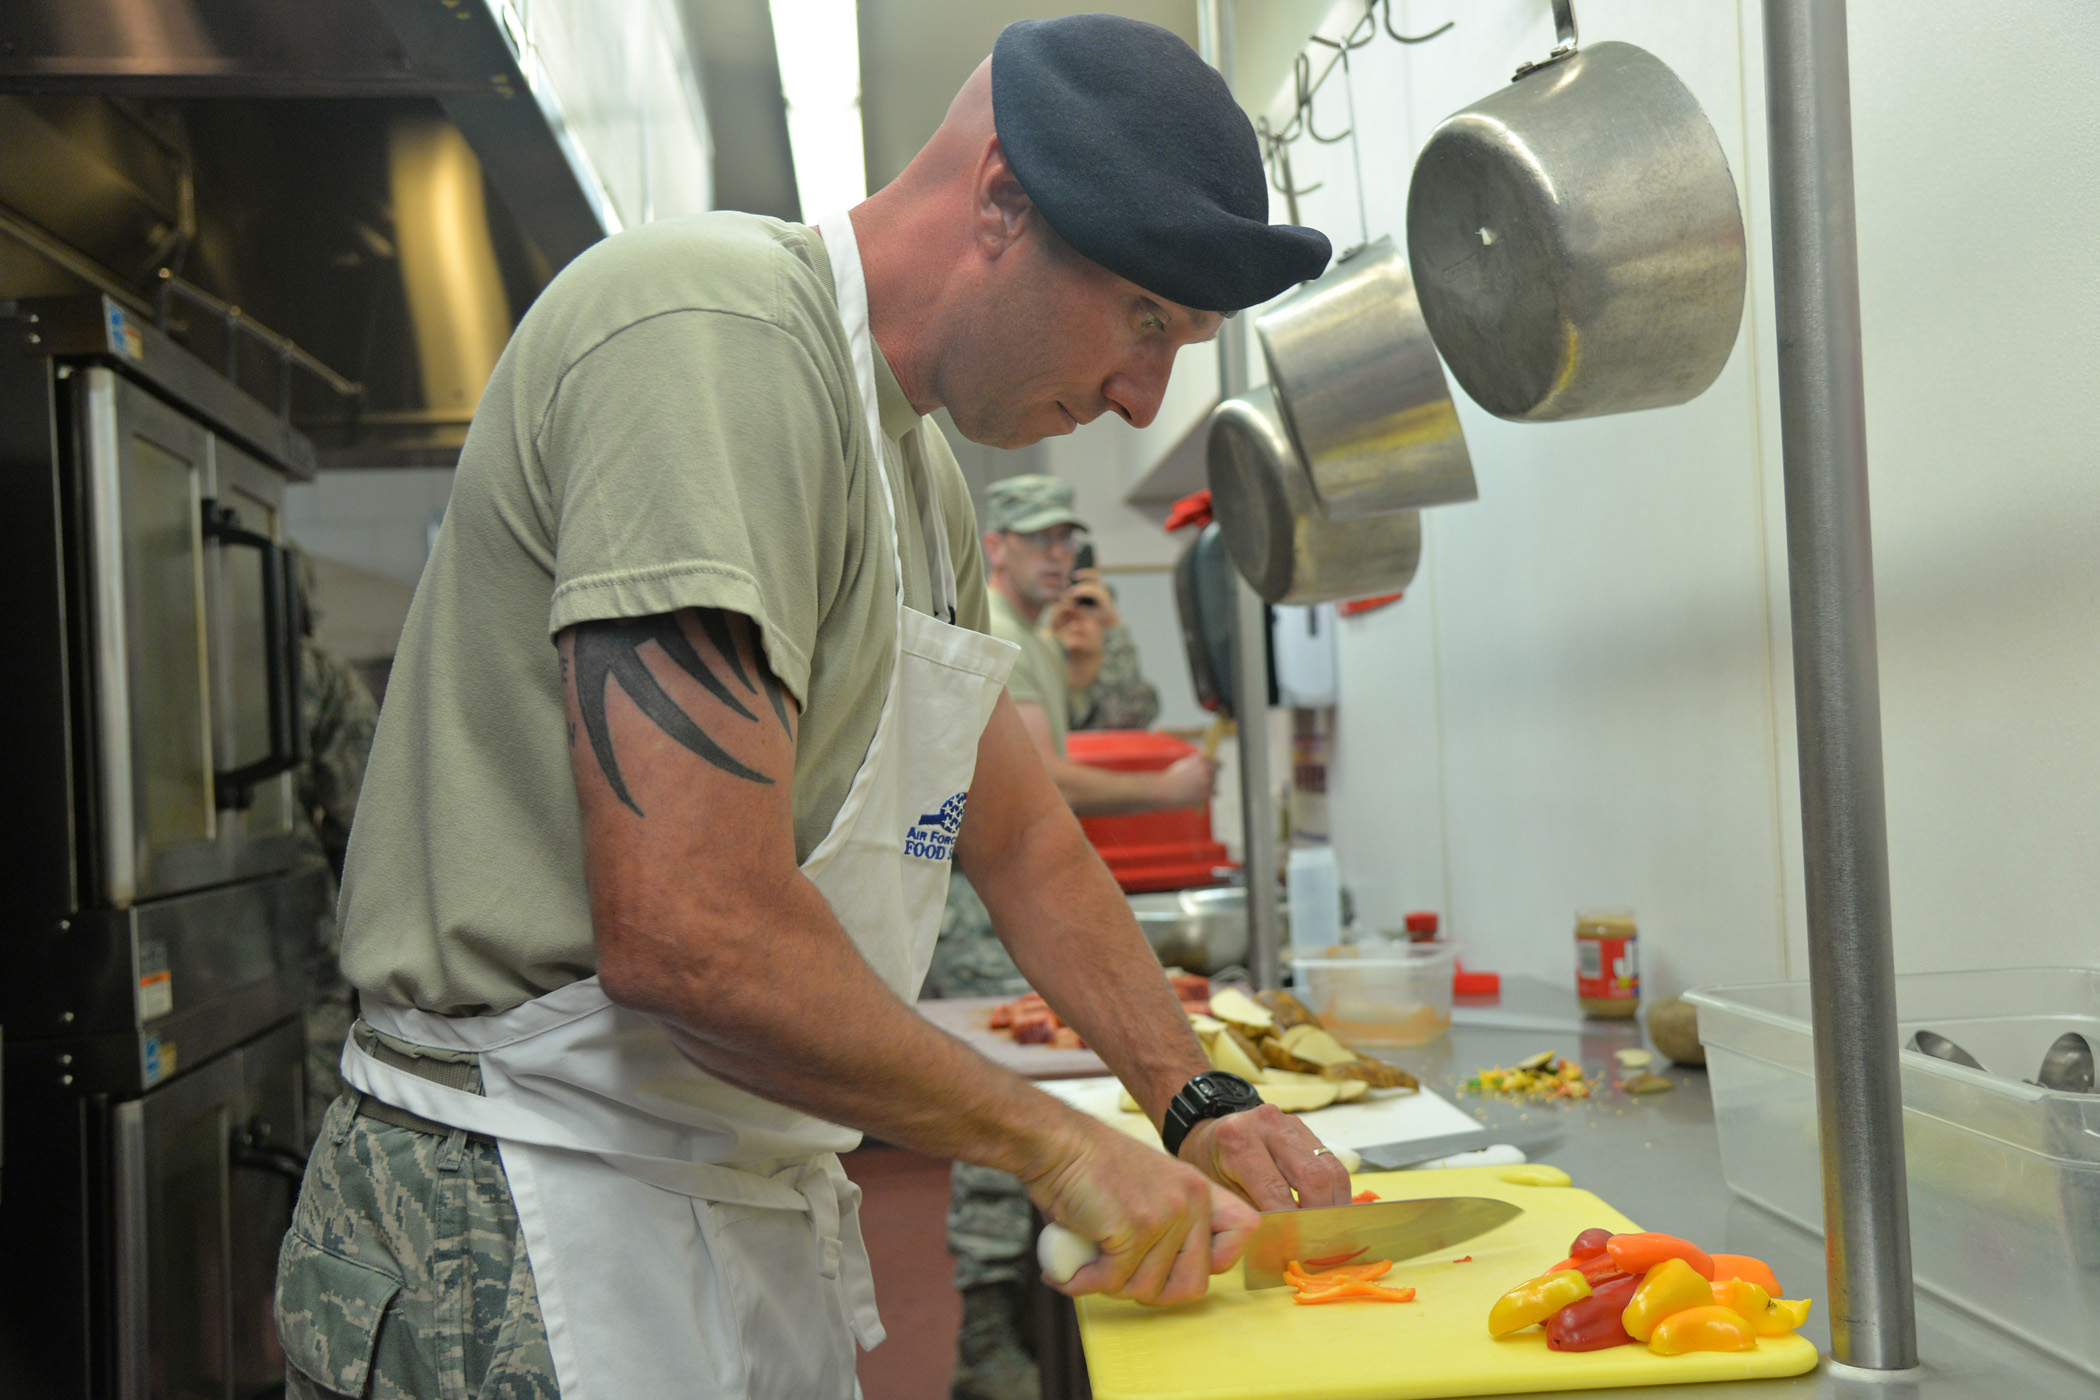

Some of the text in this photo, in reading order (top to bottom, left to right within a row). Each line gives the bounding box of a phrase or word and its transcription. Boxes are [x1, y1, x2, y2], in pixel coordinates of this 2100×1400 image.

[906, 827, 957, 845] AIR FORC
[904, 840, 945, 860] FOOD
